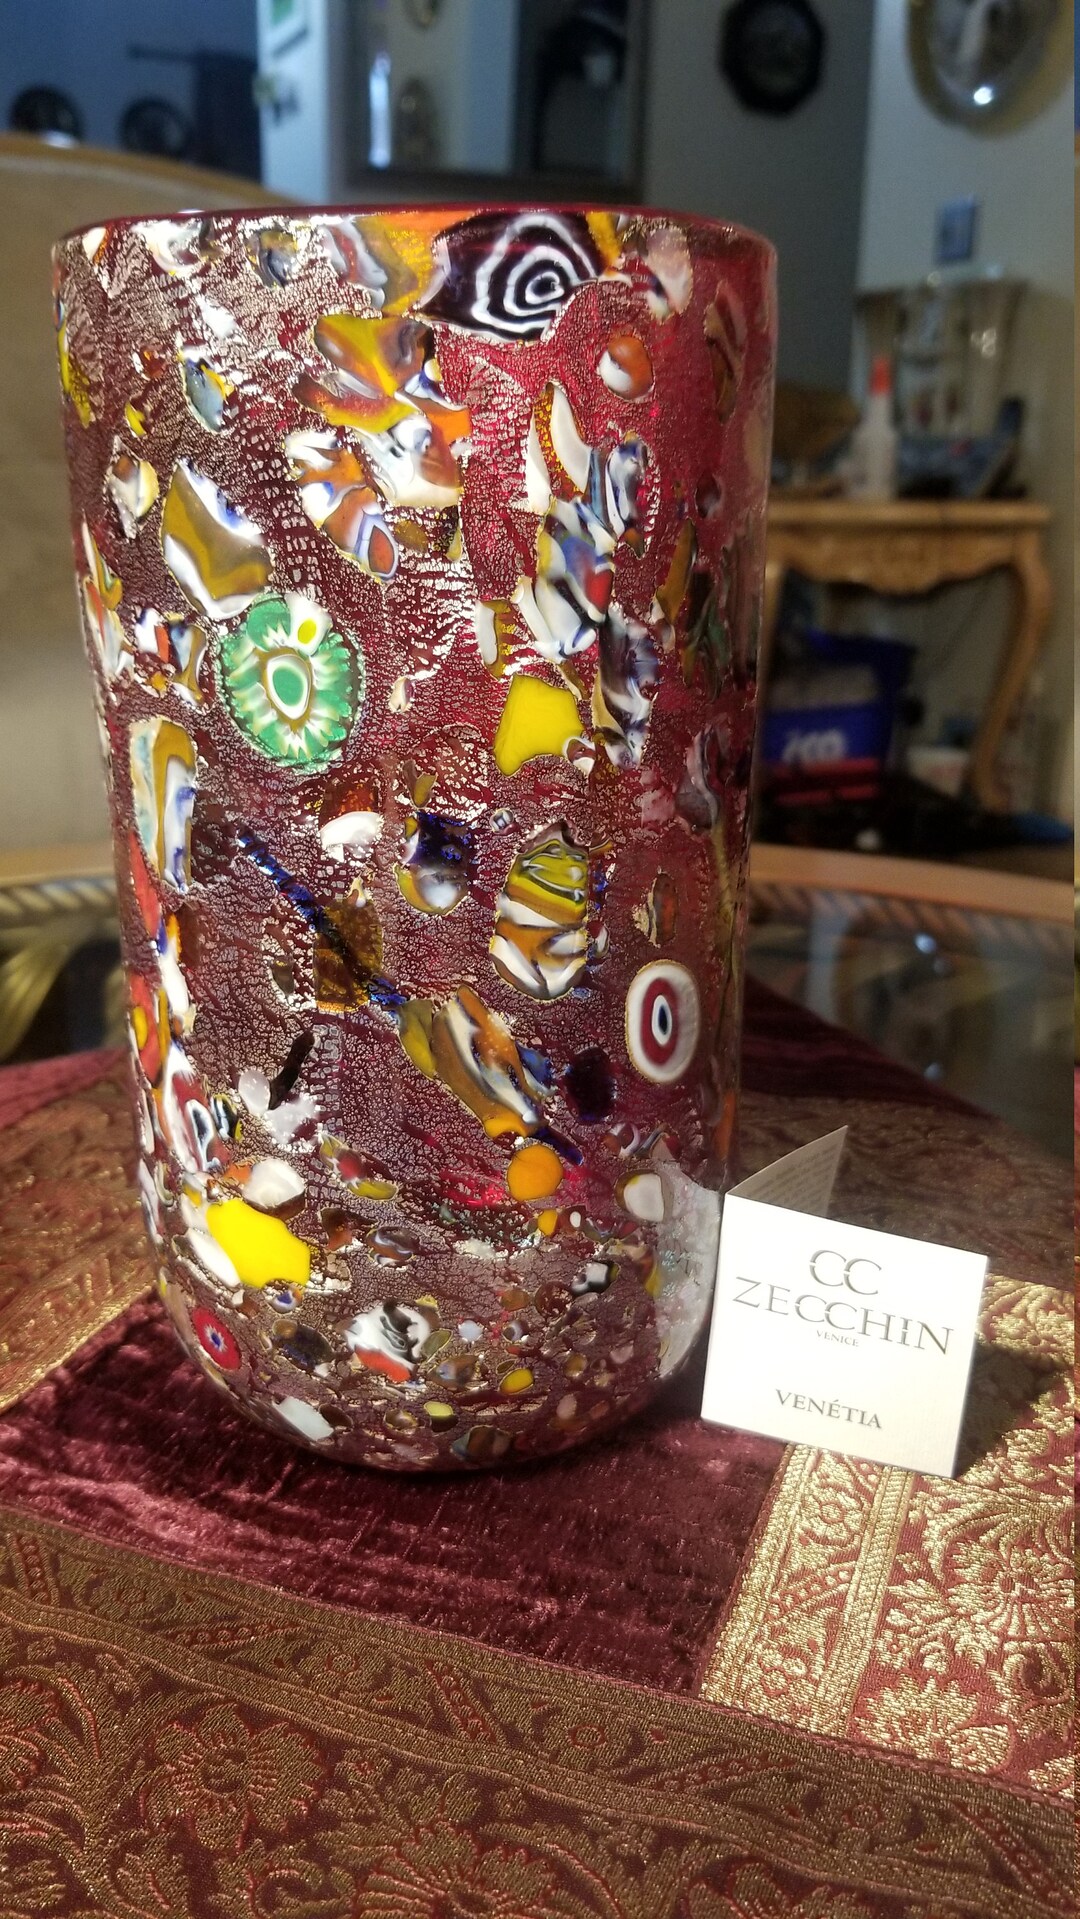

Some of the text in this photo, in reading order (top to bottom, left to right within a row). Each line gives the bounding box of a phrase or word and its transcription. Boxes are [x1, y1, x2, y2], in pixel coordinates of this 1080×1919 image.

[732, 1276, 954, 1355] ZECCHIN
[816, 1329, 859, 1347] VENICE
[775, 1388, 882, 1430] VENÉTIA
